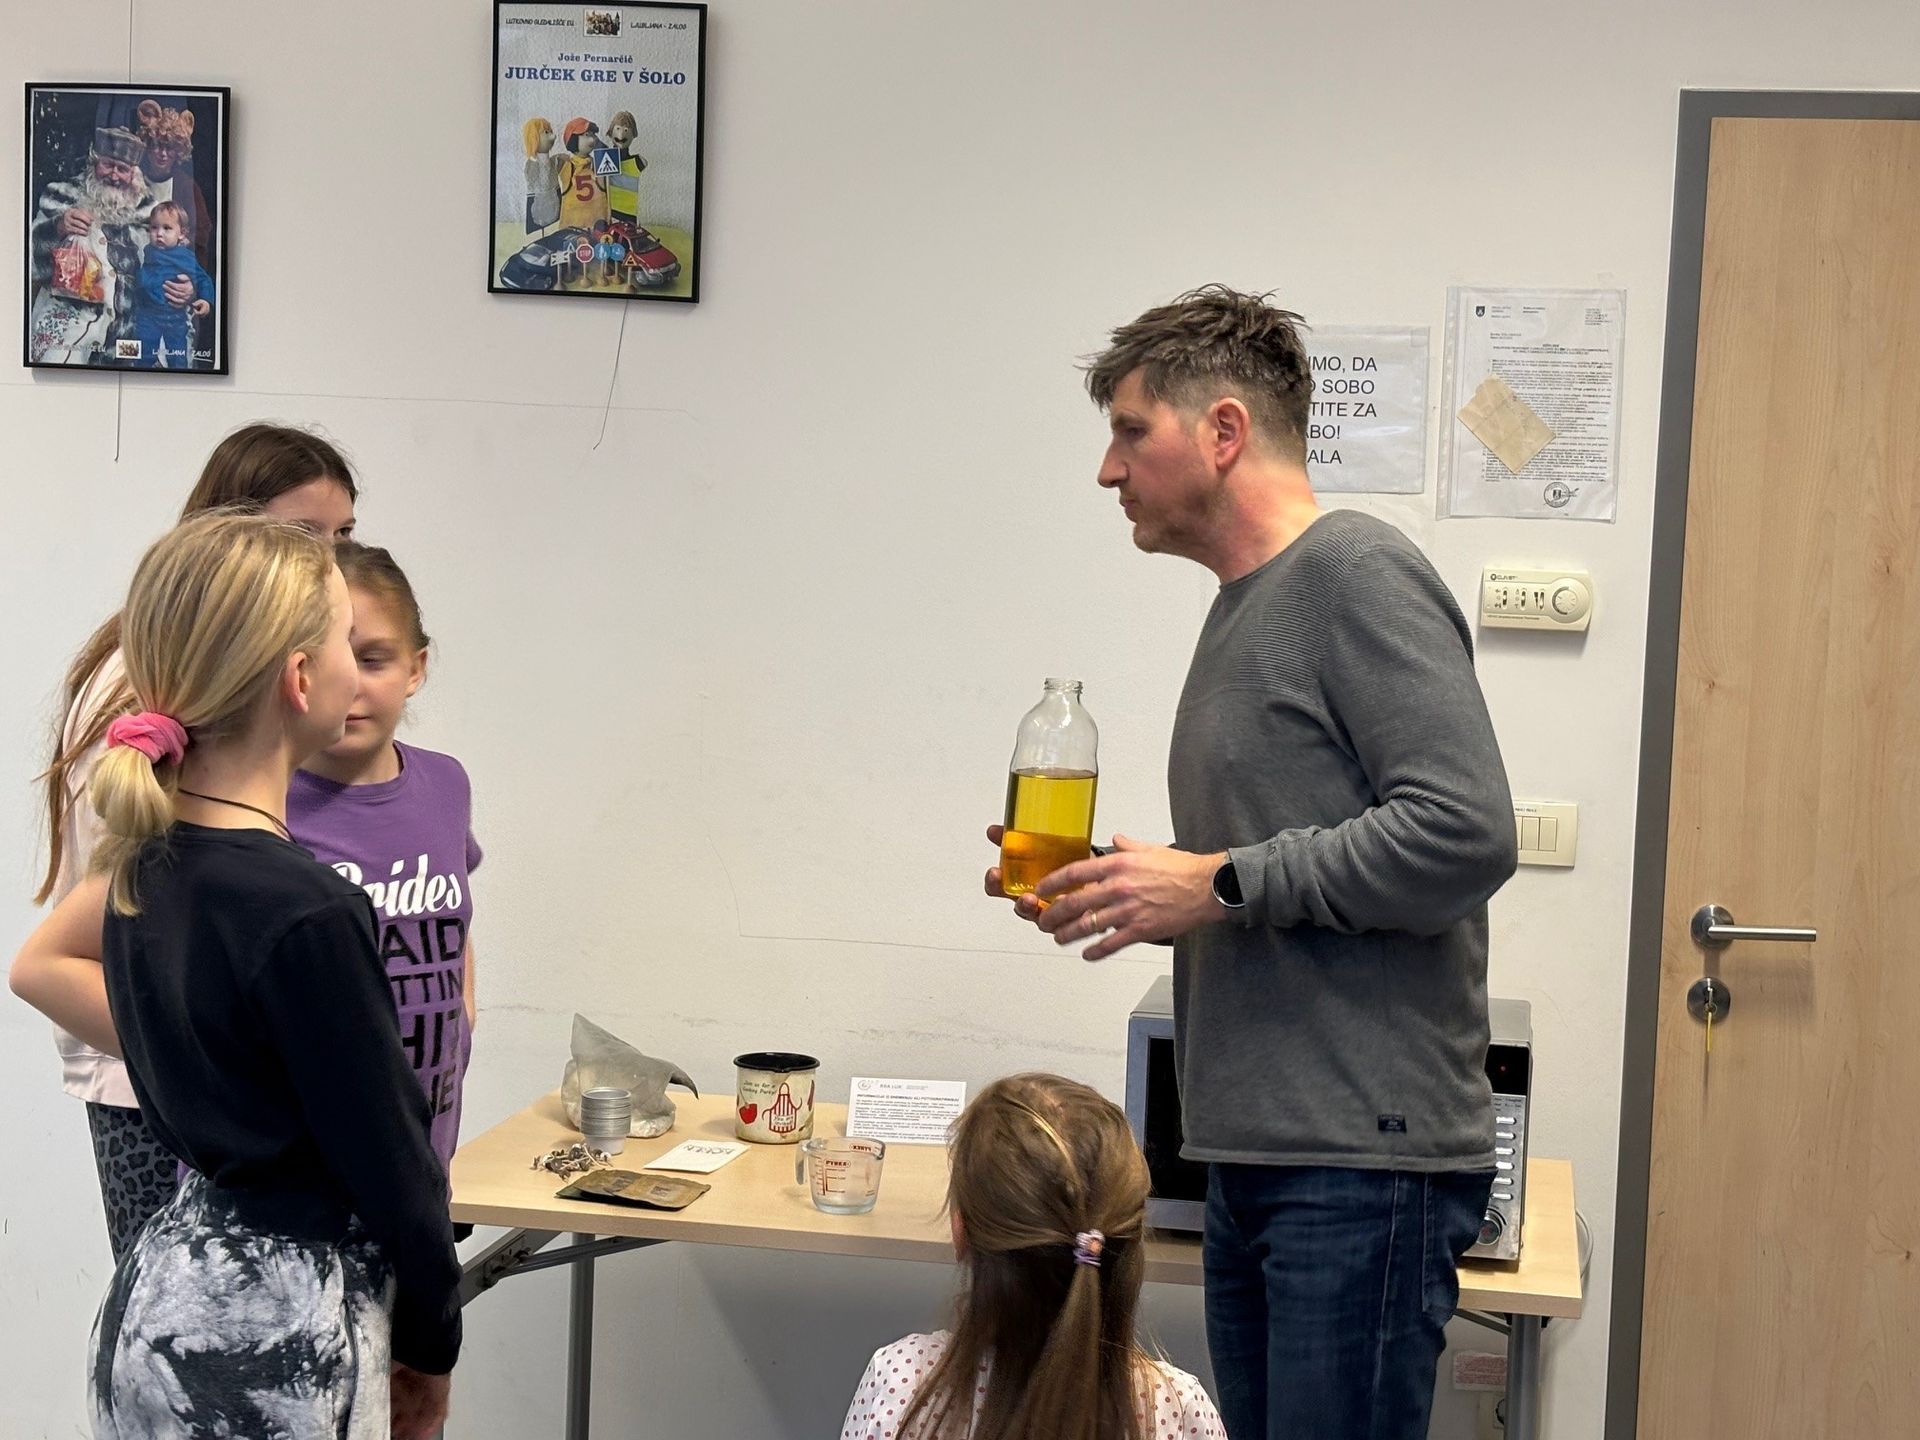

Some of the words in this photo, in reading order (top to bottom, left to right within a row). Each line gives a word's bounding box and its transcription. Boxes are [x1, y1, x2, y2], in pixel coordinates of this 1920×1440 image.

[558, 53, 580, 62] Jože
[505, 64, 576, 81] JURČEK
[580, 69, 617, 83] GRE
[622, 70, 634, 83] V
[639, 67, 686, 85] ŠOLO
[575, 174, 594, 201] 5
[1308, 356, 1346, 373] IMO,
[1352, 356, 1377, 371] DA
[1322, 379, 1375, 394] SOBO
[1309, 401, 1348, 417] TITE
[1353, 402, 1377, 417] ZA
[1307, 449, 1342, 464] ALA
[381, 917, 466, 965] AID
[390, 968, 463, 1006] TTIN
